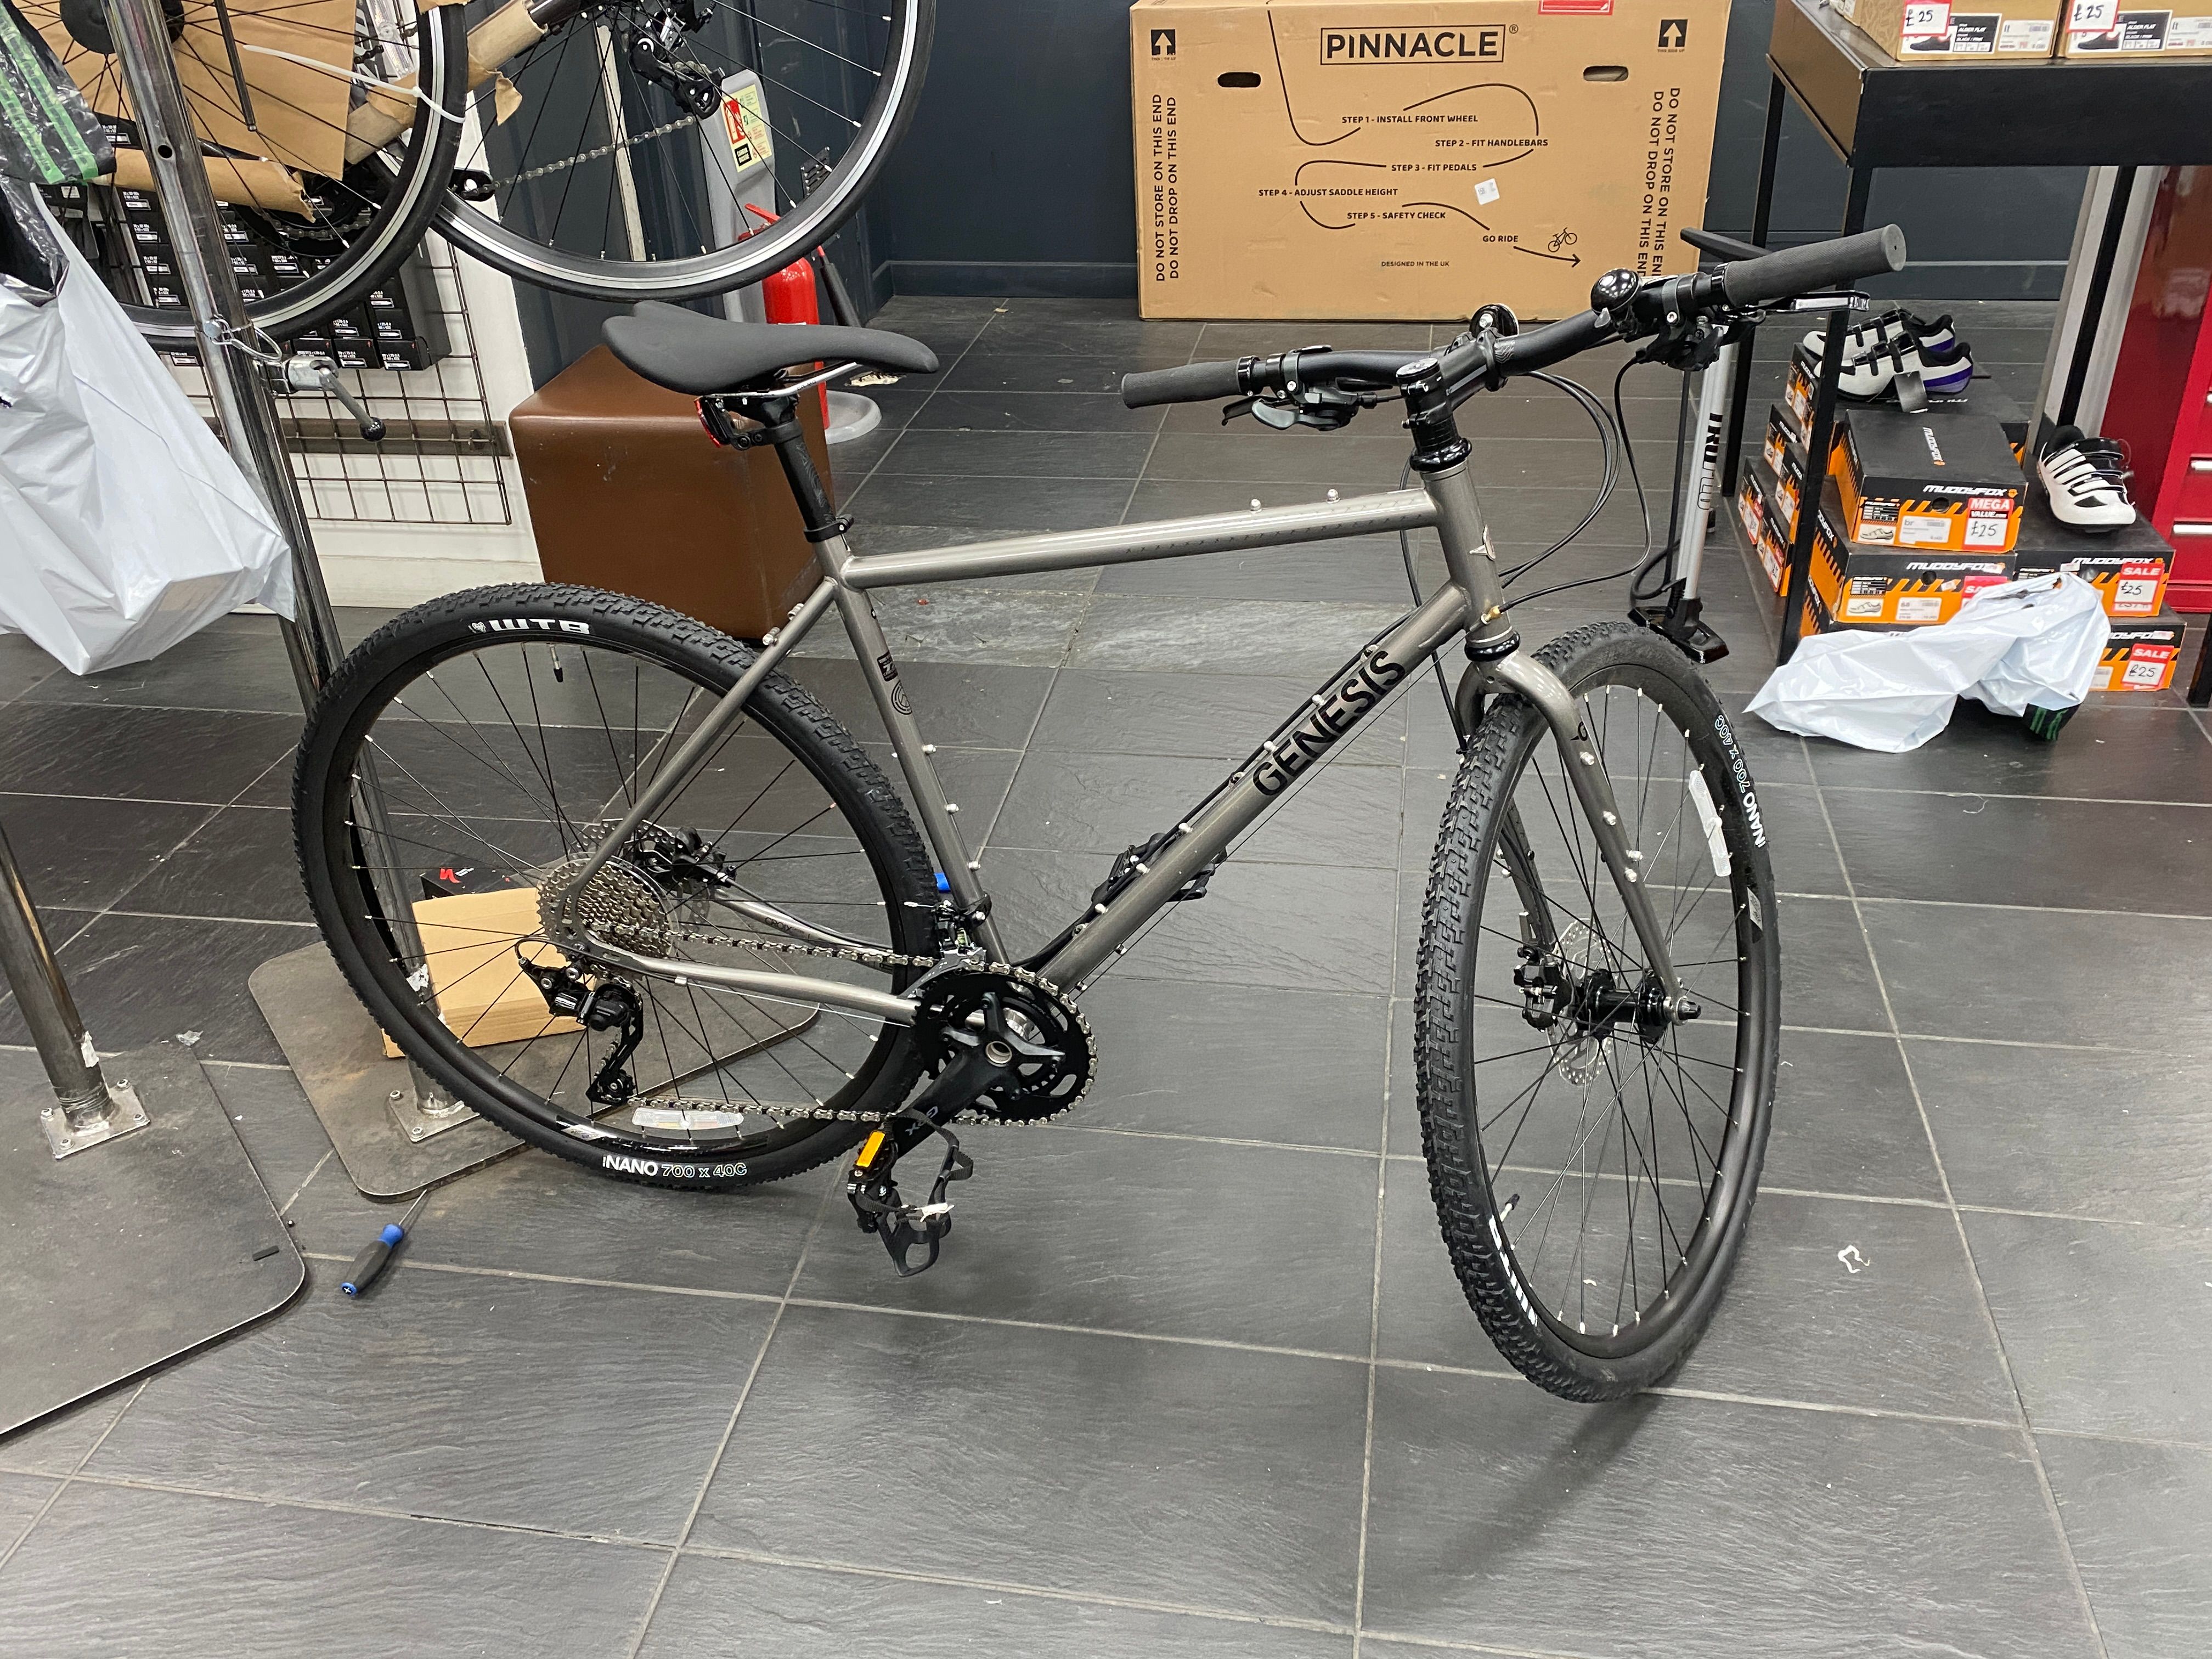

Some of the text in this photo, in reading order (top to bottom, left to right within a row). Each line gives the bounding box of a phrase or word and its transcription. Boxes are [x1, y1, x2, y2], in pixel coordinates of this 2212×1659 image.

[2074, 4, 2104, 22] £25
[1327, 31, 1498, 59] PINNACLE
[1653, 91, 1664, 112] DO
[1669, 88, 1681, 109] DO
[1649, 117, 1662, 146] NOT
[1665, 114, 1678, 143] NOT
[1487, 139, 1548, 147] HANDLEBARS
[1646, 151, 1658, 190] DROP
[1660, 148, 1673, 193] STORE
[1153, 94, 1165, 281] DO NOT STORE ON THIS END
[1167, 97, 1178, 279] DO NOT DROP ON THIS END
[1643, 194, 1654, 214] ON
[1658, 196, 1668, 217] ON
[1639, 218, 1651, 248] THIS
[1654, 221, 1667, 251] THIS
[1923, 484, 2008, 496] MUDDYFOX
[1970, 498, 2010, 510] MEGA
[1971, 521, 1999, 538] £25
[1906, 562, 1986, 571] MUDDYFO
[2122, 567, 2162, 576] SALE
[2121, 582, 2142, 595] £25
[489, 618, 590, 635] WTB
[2134, 648, 2171, 659] SALE
[2129, 665, 2156, 677] £25
[1253, 650, 1405, 795] GENESIS
[1714, 714, 1734, 745] 40C
[1733, 758, 1751, 794] 700
[1743, 792, 1767, 848] NANO
[606, 1155, 748, 1178] NANO 700 x 40C
